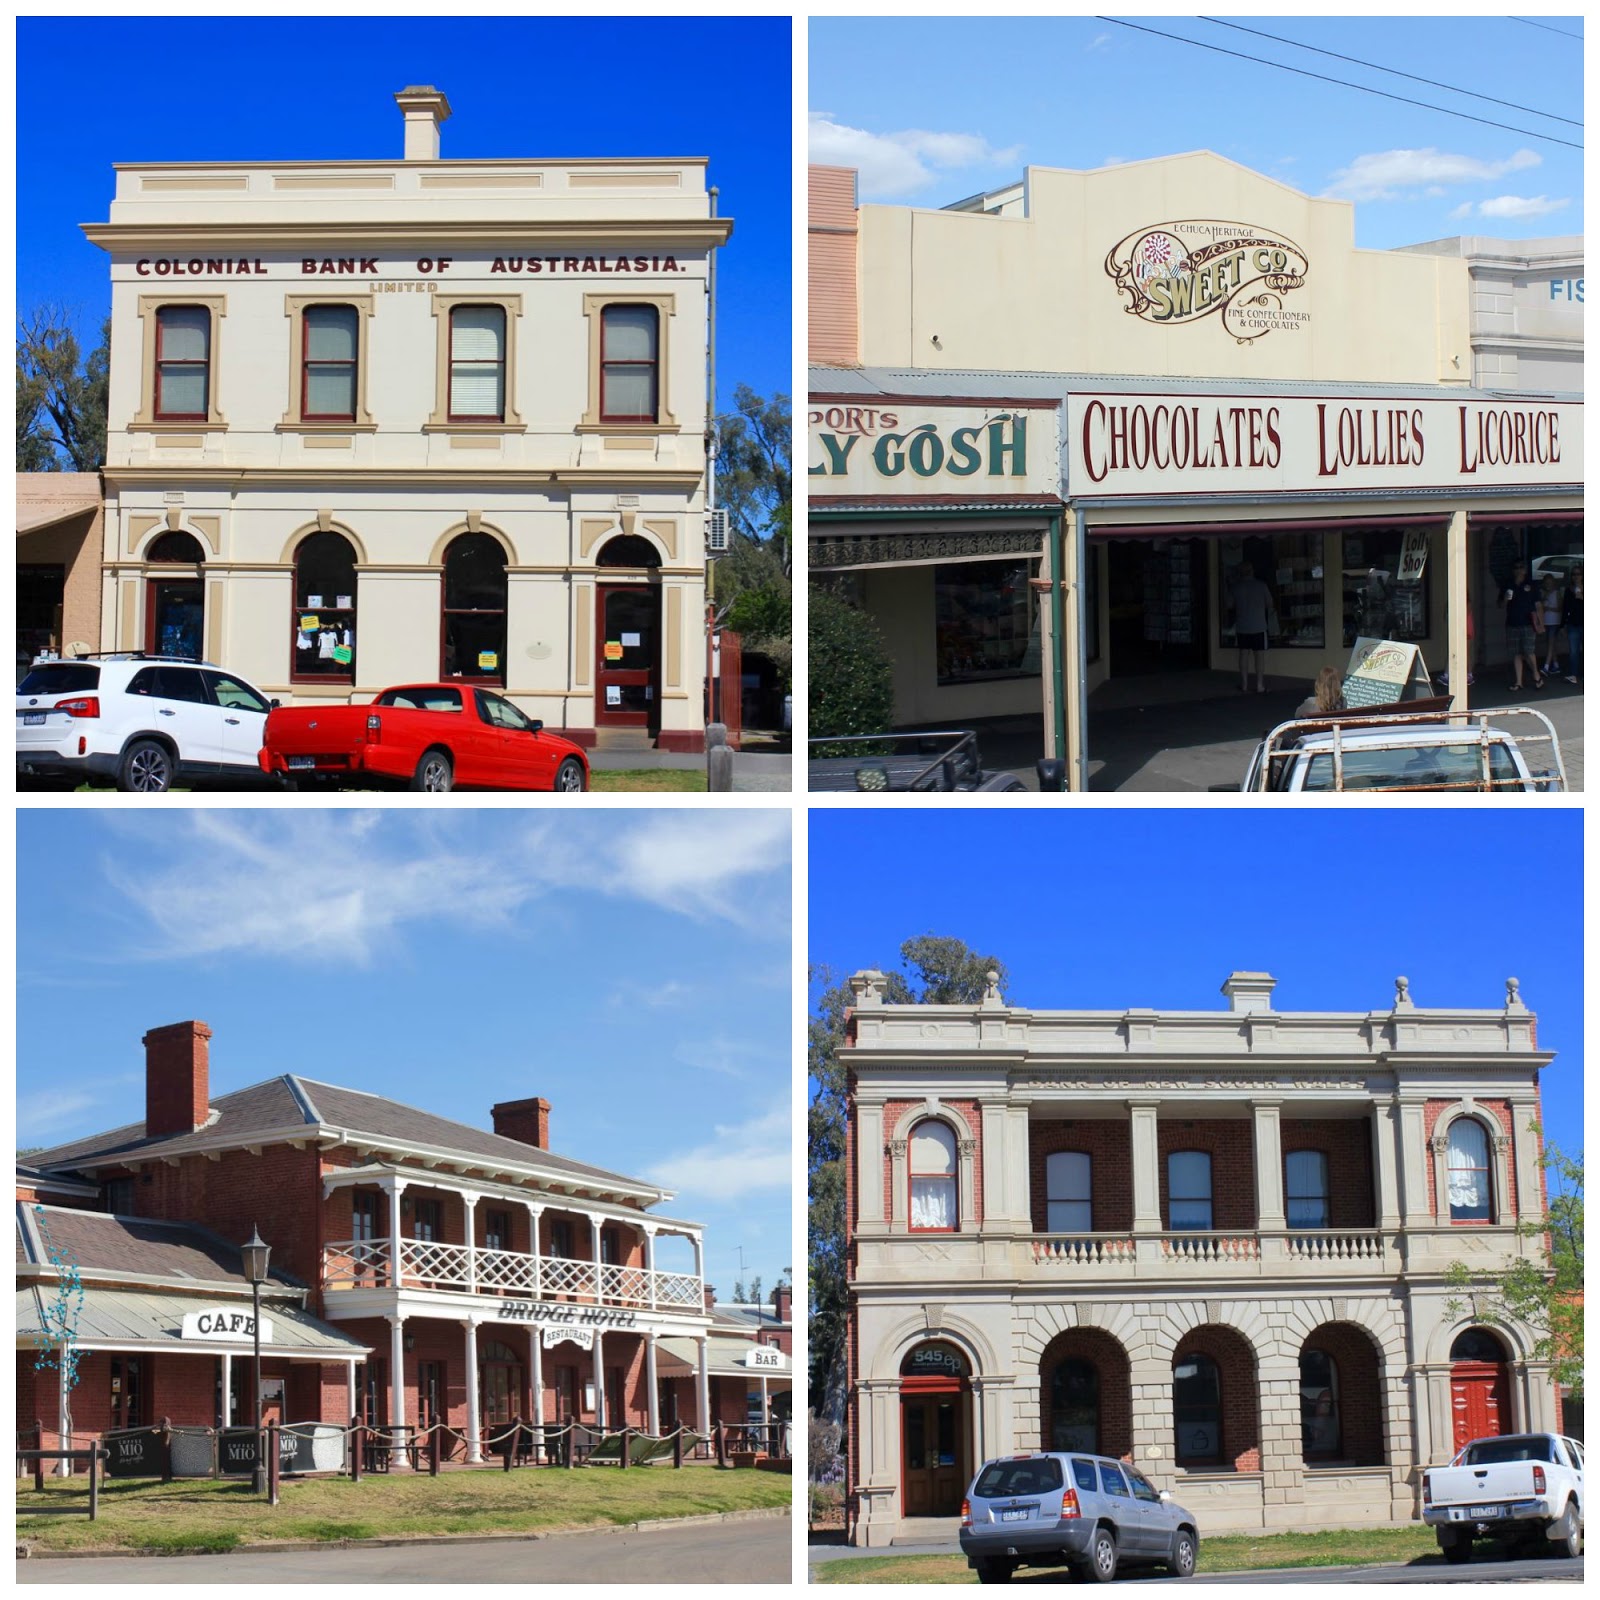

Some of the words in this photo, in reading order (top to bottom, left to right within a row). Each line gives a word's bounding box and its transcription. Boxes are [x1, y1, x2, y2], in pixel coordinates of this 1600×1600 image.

[1174, 224, 1211, 235] ECHUCA
[1212, 225, 1254, 241] HERITAGE
[136, 258, 268, 276] COLONIAL
[302, 257, 380, 274] BANK
[416, 257, 452, 273] OF
[490, 256, 686, 273] AUSTRALASIA.
[369, 281, 438, 293] LIMITED
[1150, 250, 1245, 320] SWEET
[1228, 308, 1244, 318] FINE
[1247, 309, 1311, 321] CONFECTIONERY
[1240, 318, 1247, 327] &
[1249, 319, 1300, 330] CHOCOLATES
[872, 413, 1027, 476] GOSH
[1082, 399, 1281, 482] CHOCOLATES
[1317, 403, 1424, 475] LOLLIES
[1459, 406, 1560, 473] LICORICE
[1028, 1075, 1090, 1088] BANK
[1102, 1075, 1130, 1088] OF
[1144, 1075, 1190, 1088] NEW
[1203, 1075, 1278, 1088] SOUTH
[1293, 1075, 1366, 1088] WALES
[497, 1300, 577, 1324] BRIDGE
[580, 1308, 636, 1328] HOTEL
[197, 1313, 255, 1336] CAFE
[546, 1328, 591, 1344] RESTAURANT
[755, 1352, 778, 1366] BAR
[915, 1350, 943, 1362] 545
[119, 1443, 143, 1456] MIO
[280, 1439, 297, 1451] MIO
[228, 1448, 255, 1460] MIO
